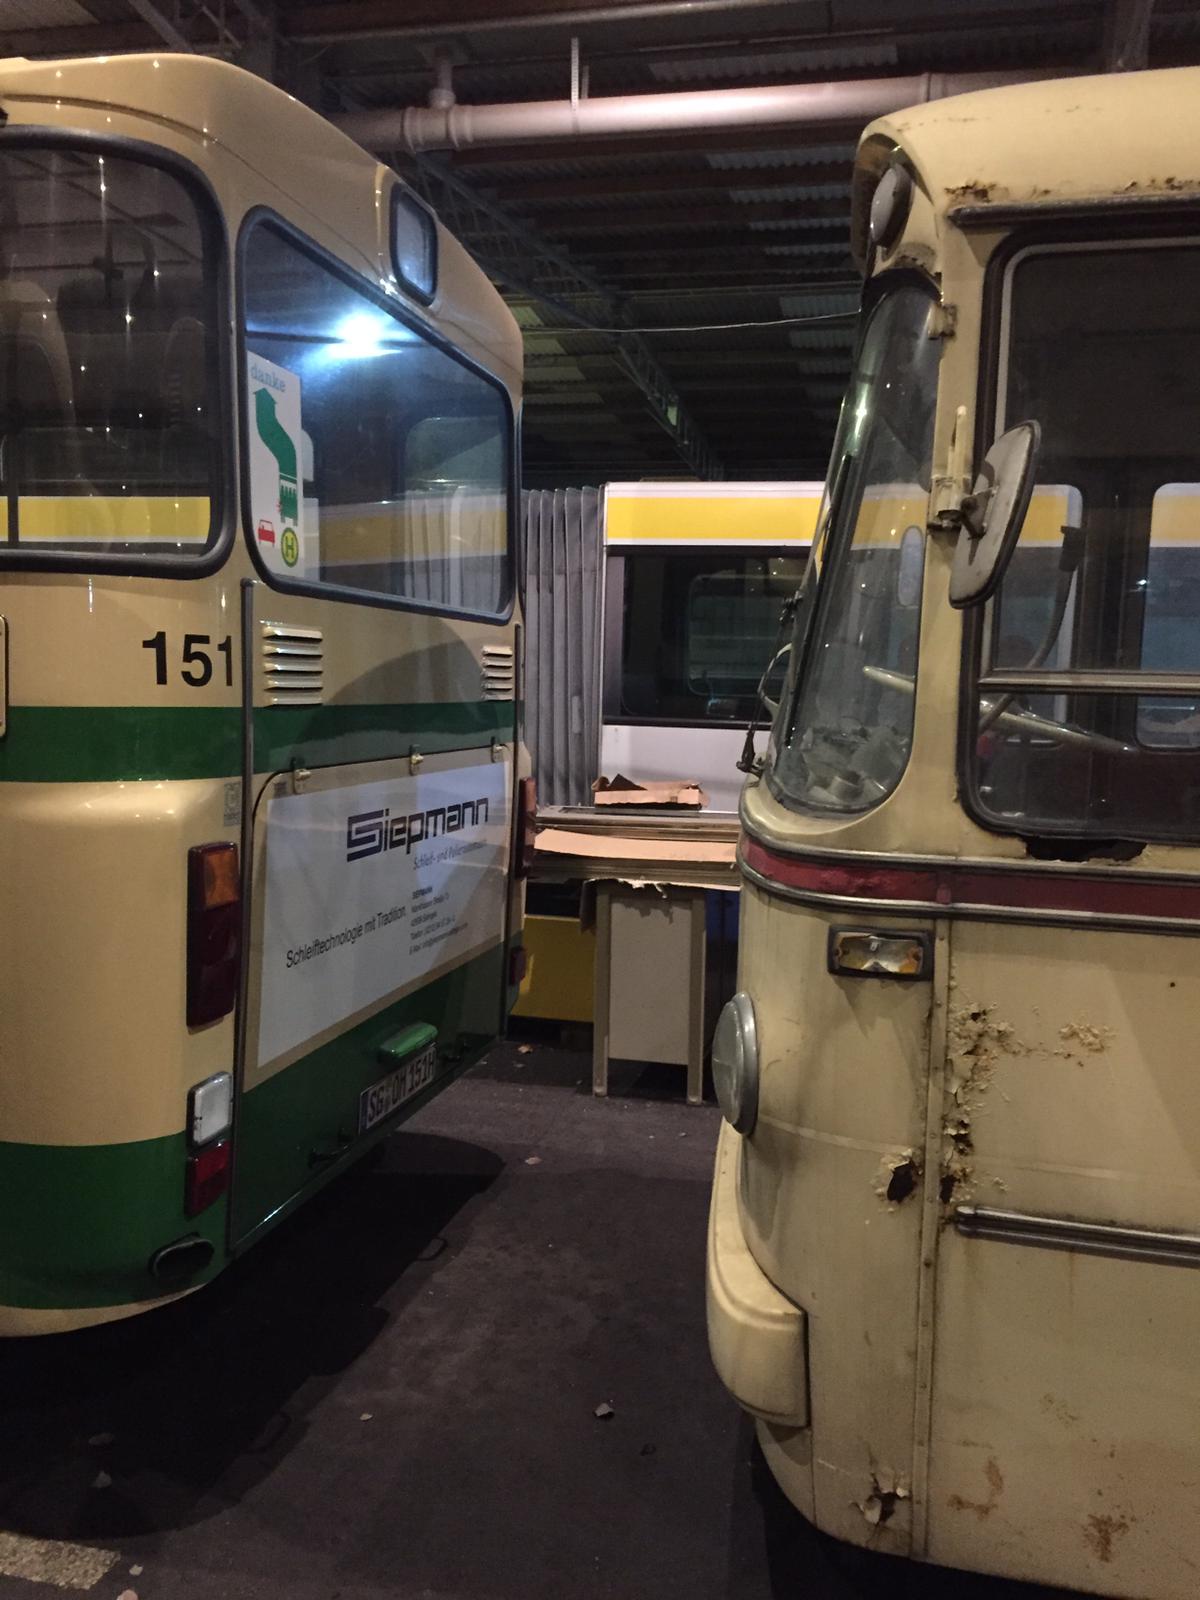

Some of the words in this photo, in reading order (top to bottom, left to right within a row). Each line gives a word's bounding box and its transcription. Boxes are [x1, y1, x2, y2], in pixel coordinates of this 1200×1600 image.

[250, 363, 286, 393] danke
[285, 535, 295, 560] H
[142, 631, 233, 687] 151
[346, 797, 489, 863] Siepmann
[286, 921, 363, 969] Schleiftechnologie
[364, 915, 376, 934] mit
[377, 904, 406, 929] Tradition
[369, 1085, 385, 1123] SG
[408, 1051, 434, 1093] 151H
